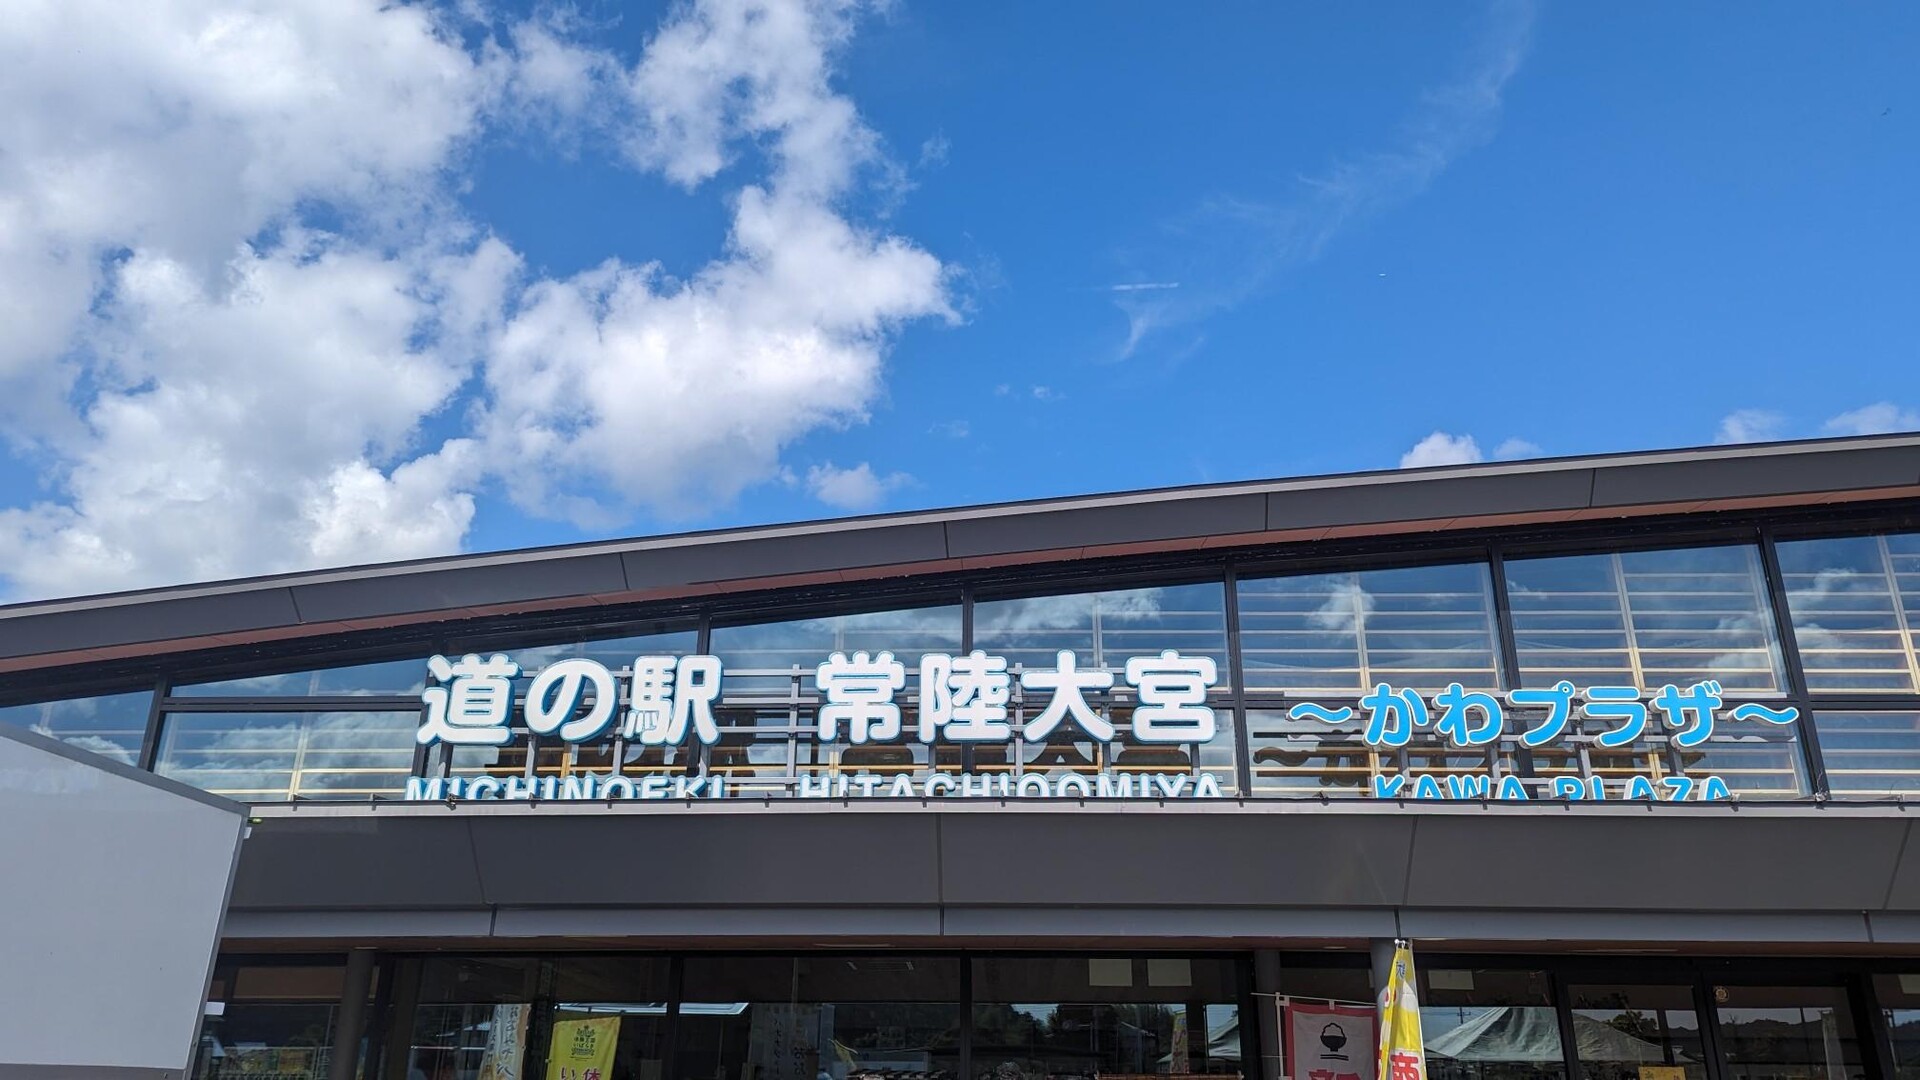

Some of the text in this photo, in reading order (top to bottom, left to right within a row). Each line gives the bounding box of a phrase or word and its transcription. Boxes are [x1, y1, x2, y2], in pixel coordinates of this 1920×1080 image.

[417, 649, 1218, 746] 道の駅 常陸大宮
